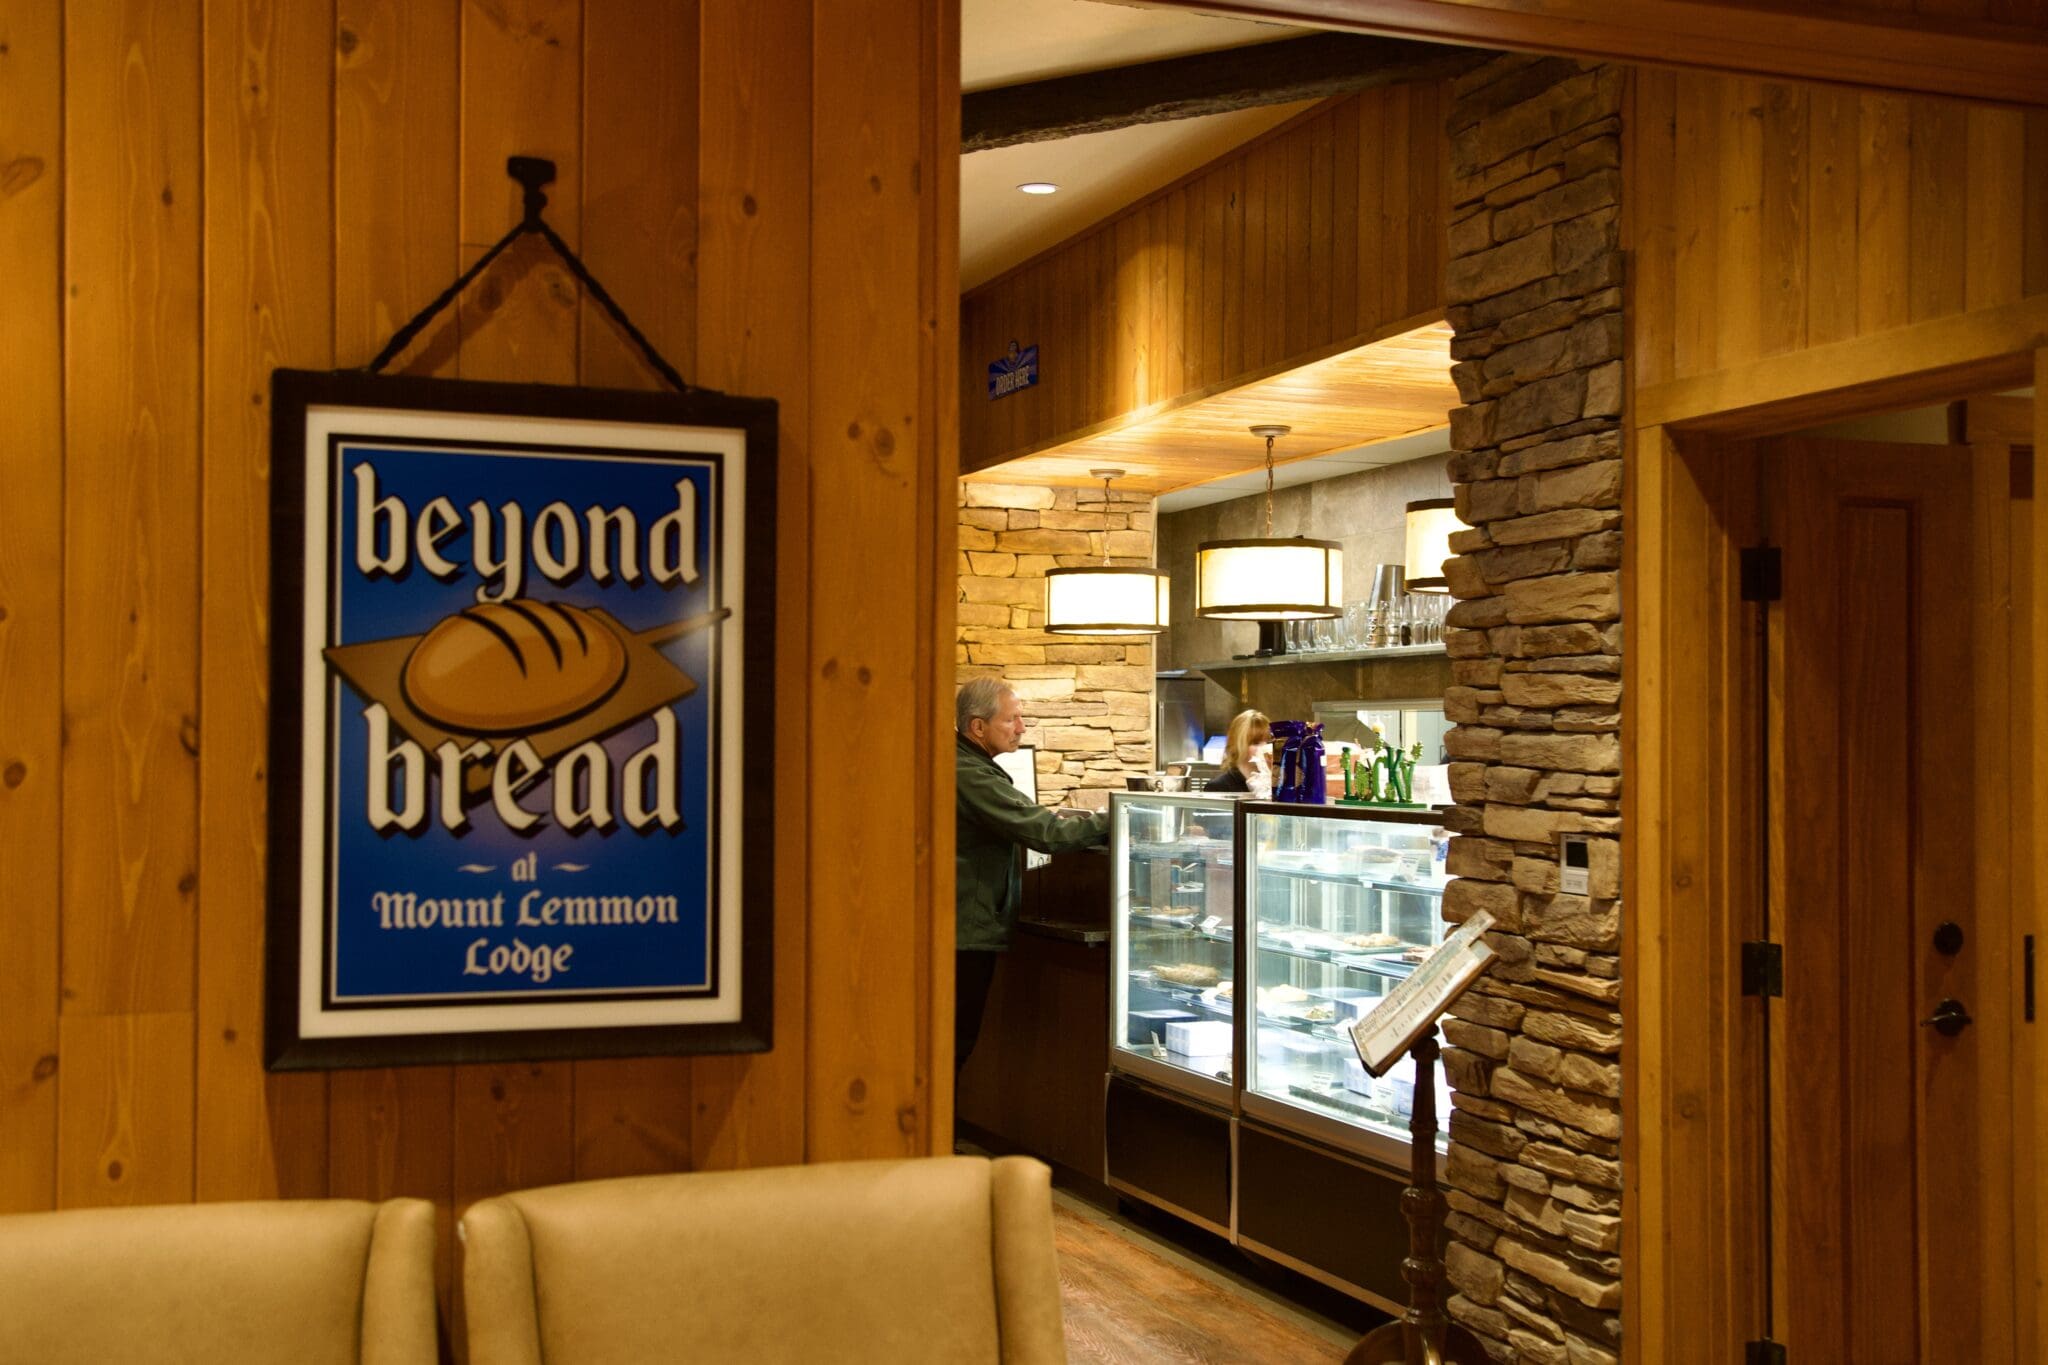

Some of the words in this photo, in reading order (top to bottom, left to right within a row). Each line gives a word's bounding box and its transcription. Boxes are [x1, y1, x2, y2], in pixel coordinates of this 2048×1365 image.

[352, 461, 699, 602] beyond
[363, 702, 681, 830] bread
[511, 852, 537, 882] at
[372, 891, 505, 929] Mount
[516, 889, 679, 926] Lemmon
[463, 937, 574, 983] Lodge
